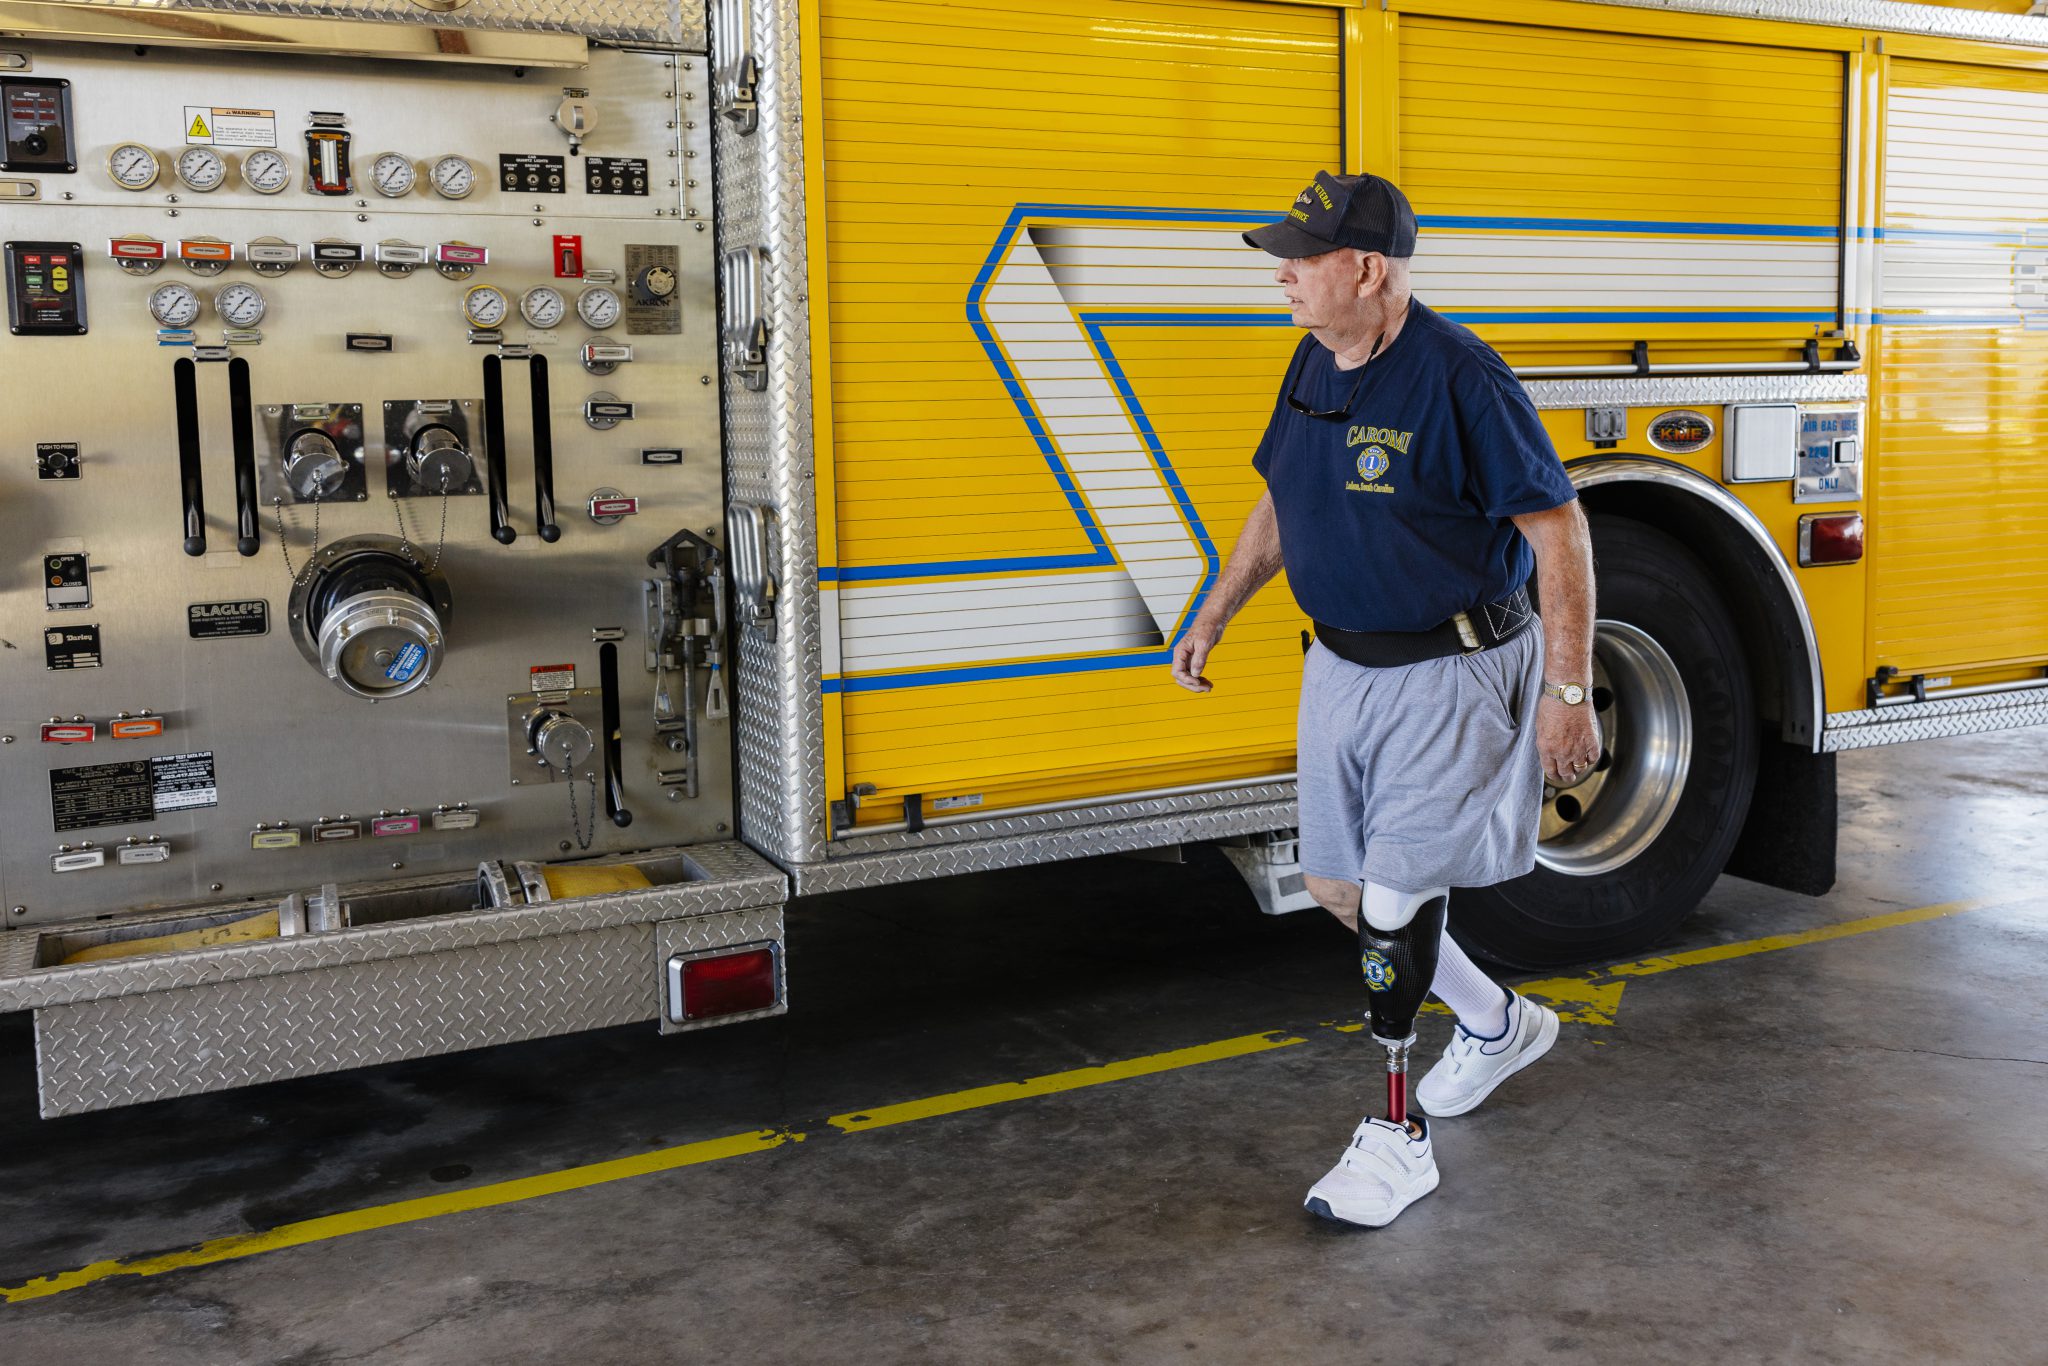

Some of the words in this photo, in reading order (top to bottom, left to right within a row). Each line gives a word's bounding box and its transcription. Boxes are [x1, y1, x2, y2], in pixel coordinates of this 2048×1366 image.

[1314, 183, 1334, 211] VETERAN
[635, 299, 670, 307] AKRON
[1814, 323, 1820, 335] 7
[1803, 420, 1818, 432] AIR
[1821, 420, 1837, 432] BAG
[1841, 419, 1857, 431] USE
[1346, 425, 1414, 455] CAROMI
[1660, 427, 1704, 442] KME
[1367, 456, 1375, 470] 1
[1819, 477, 1839, 490] ONLY
[190, 602, 263, 618] SLAGLE'S
[66, 634, 93, 642] Darley
[1370, 965, 1377, 979] 1
